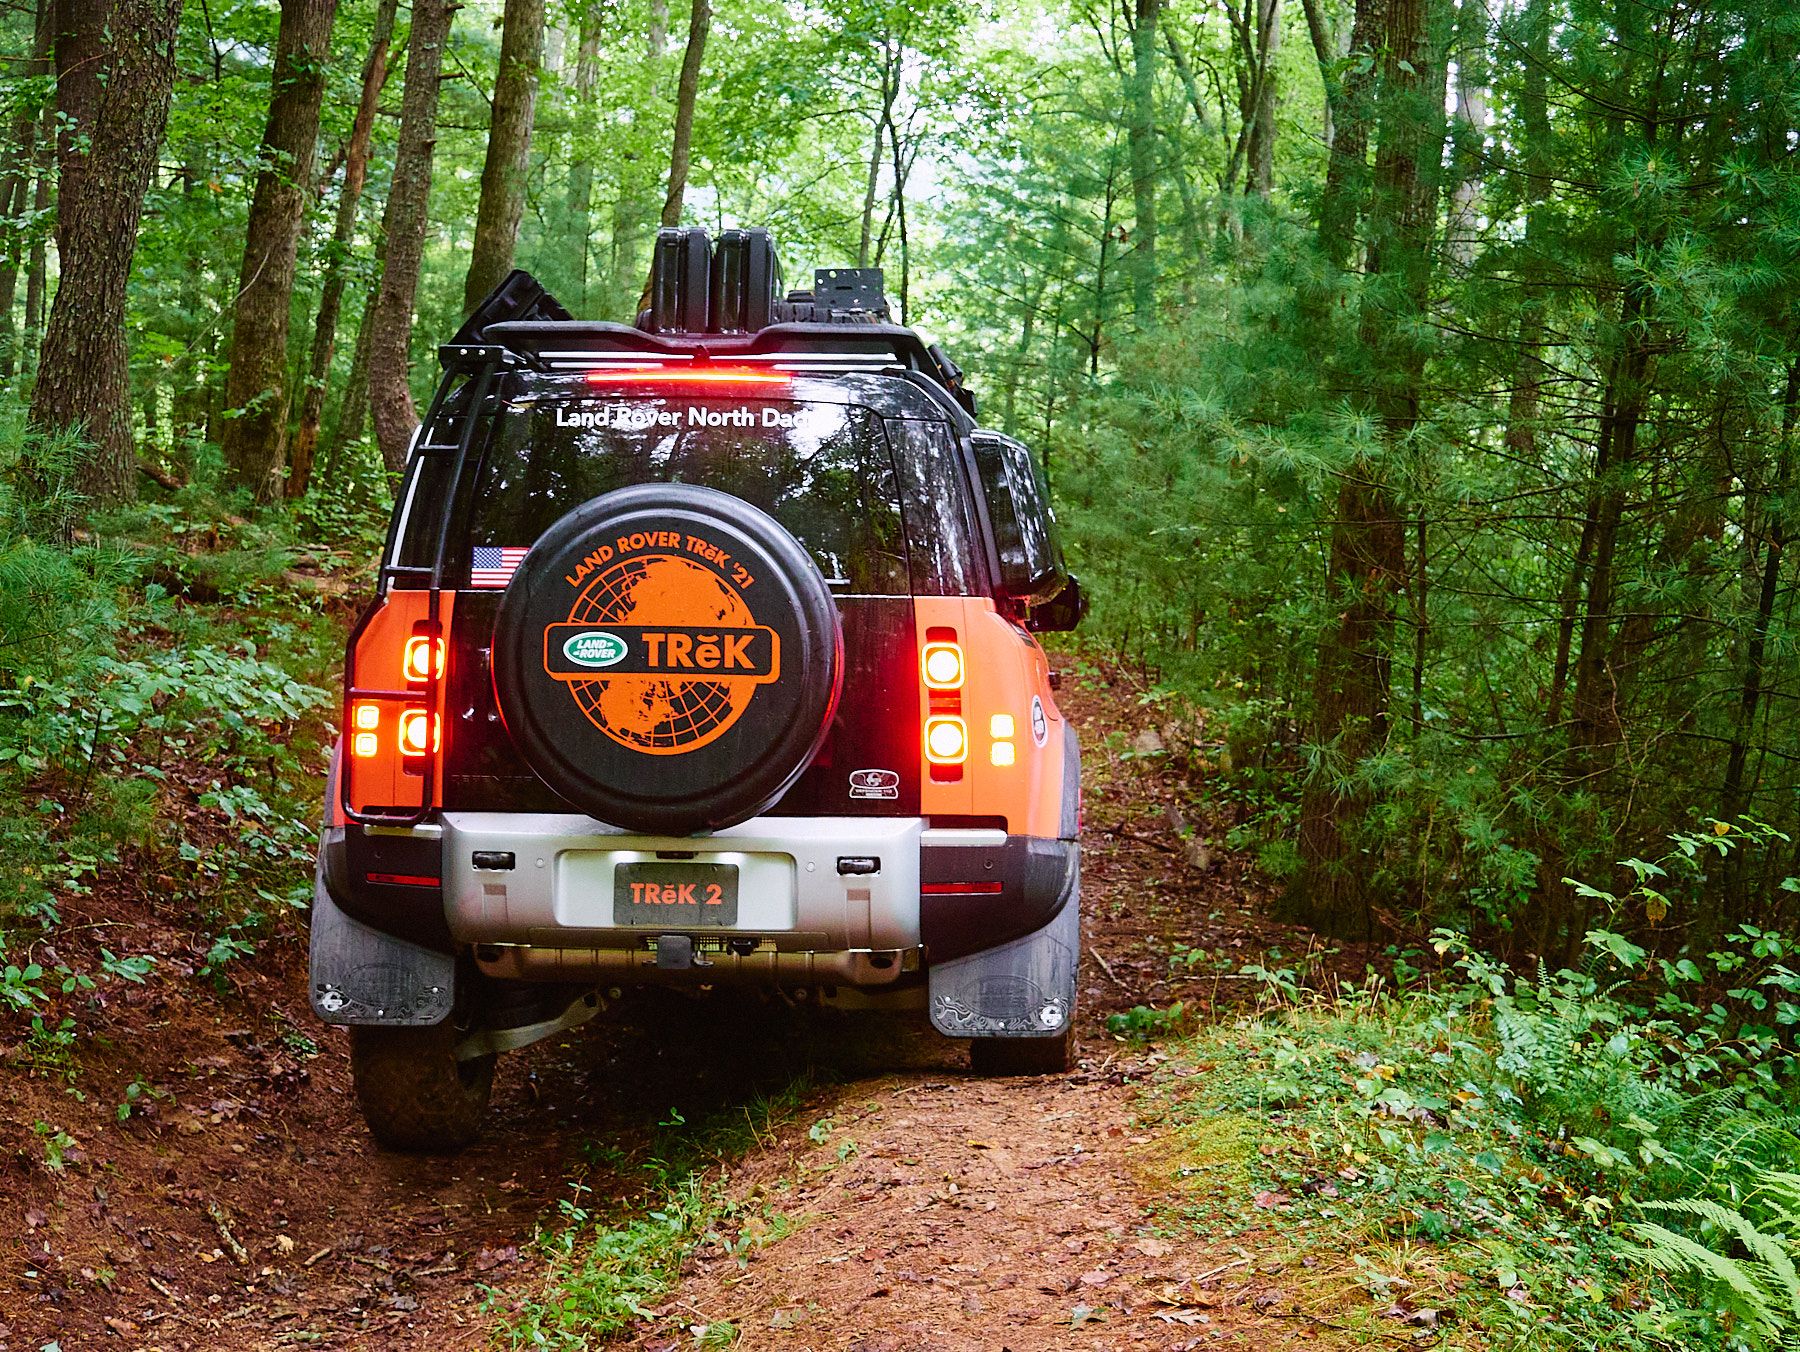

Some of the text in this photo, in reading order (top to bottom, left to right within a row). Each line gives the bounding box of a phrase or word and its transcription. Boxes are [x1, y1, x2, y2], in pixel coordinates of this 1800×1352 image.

[555, 407, 609, 427] Land
[616, 407, 680, 427] Rover
[688, 406, 754, 427] North
[565, 545, 614, 588] LAND
[616, 531, 681, 554] ROVER
[731, 562, 756, 589] '21
[577, 639, 608, 649] LAND
[579, 648, 616, 659] ROVER
[705, 883, 722, 905] 2
